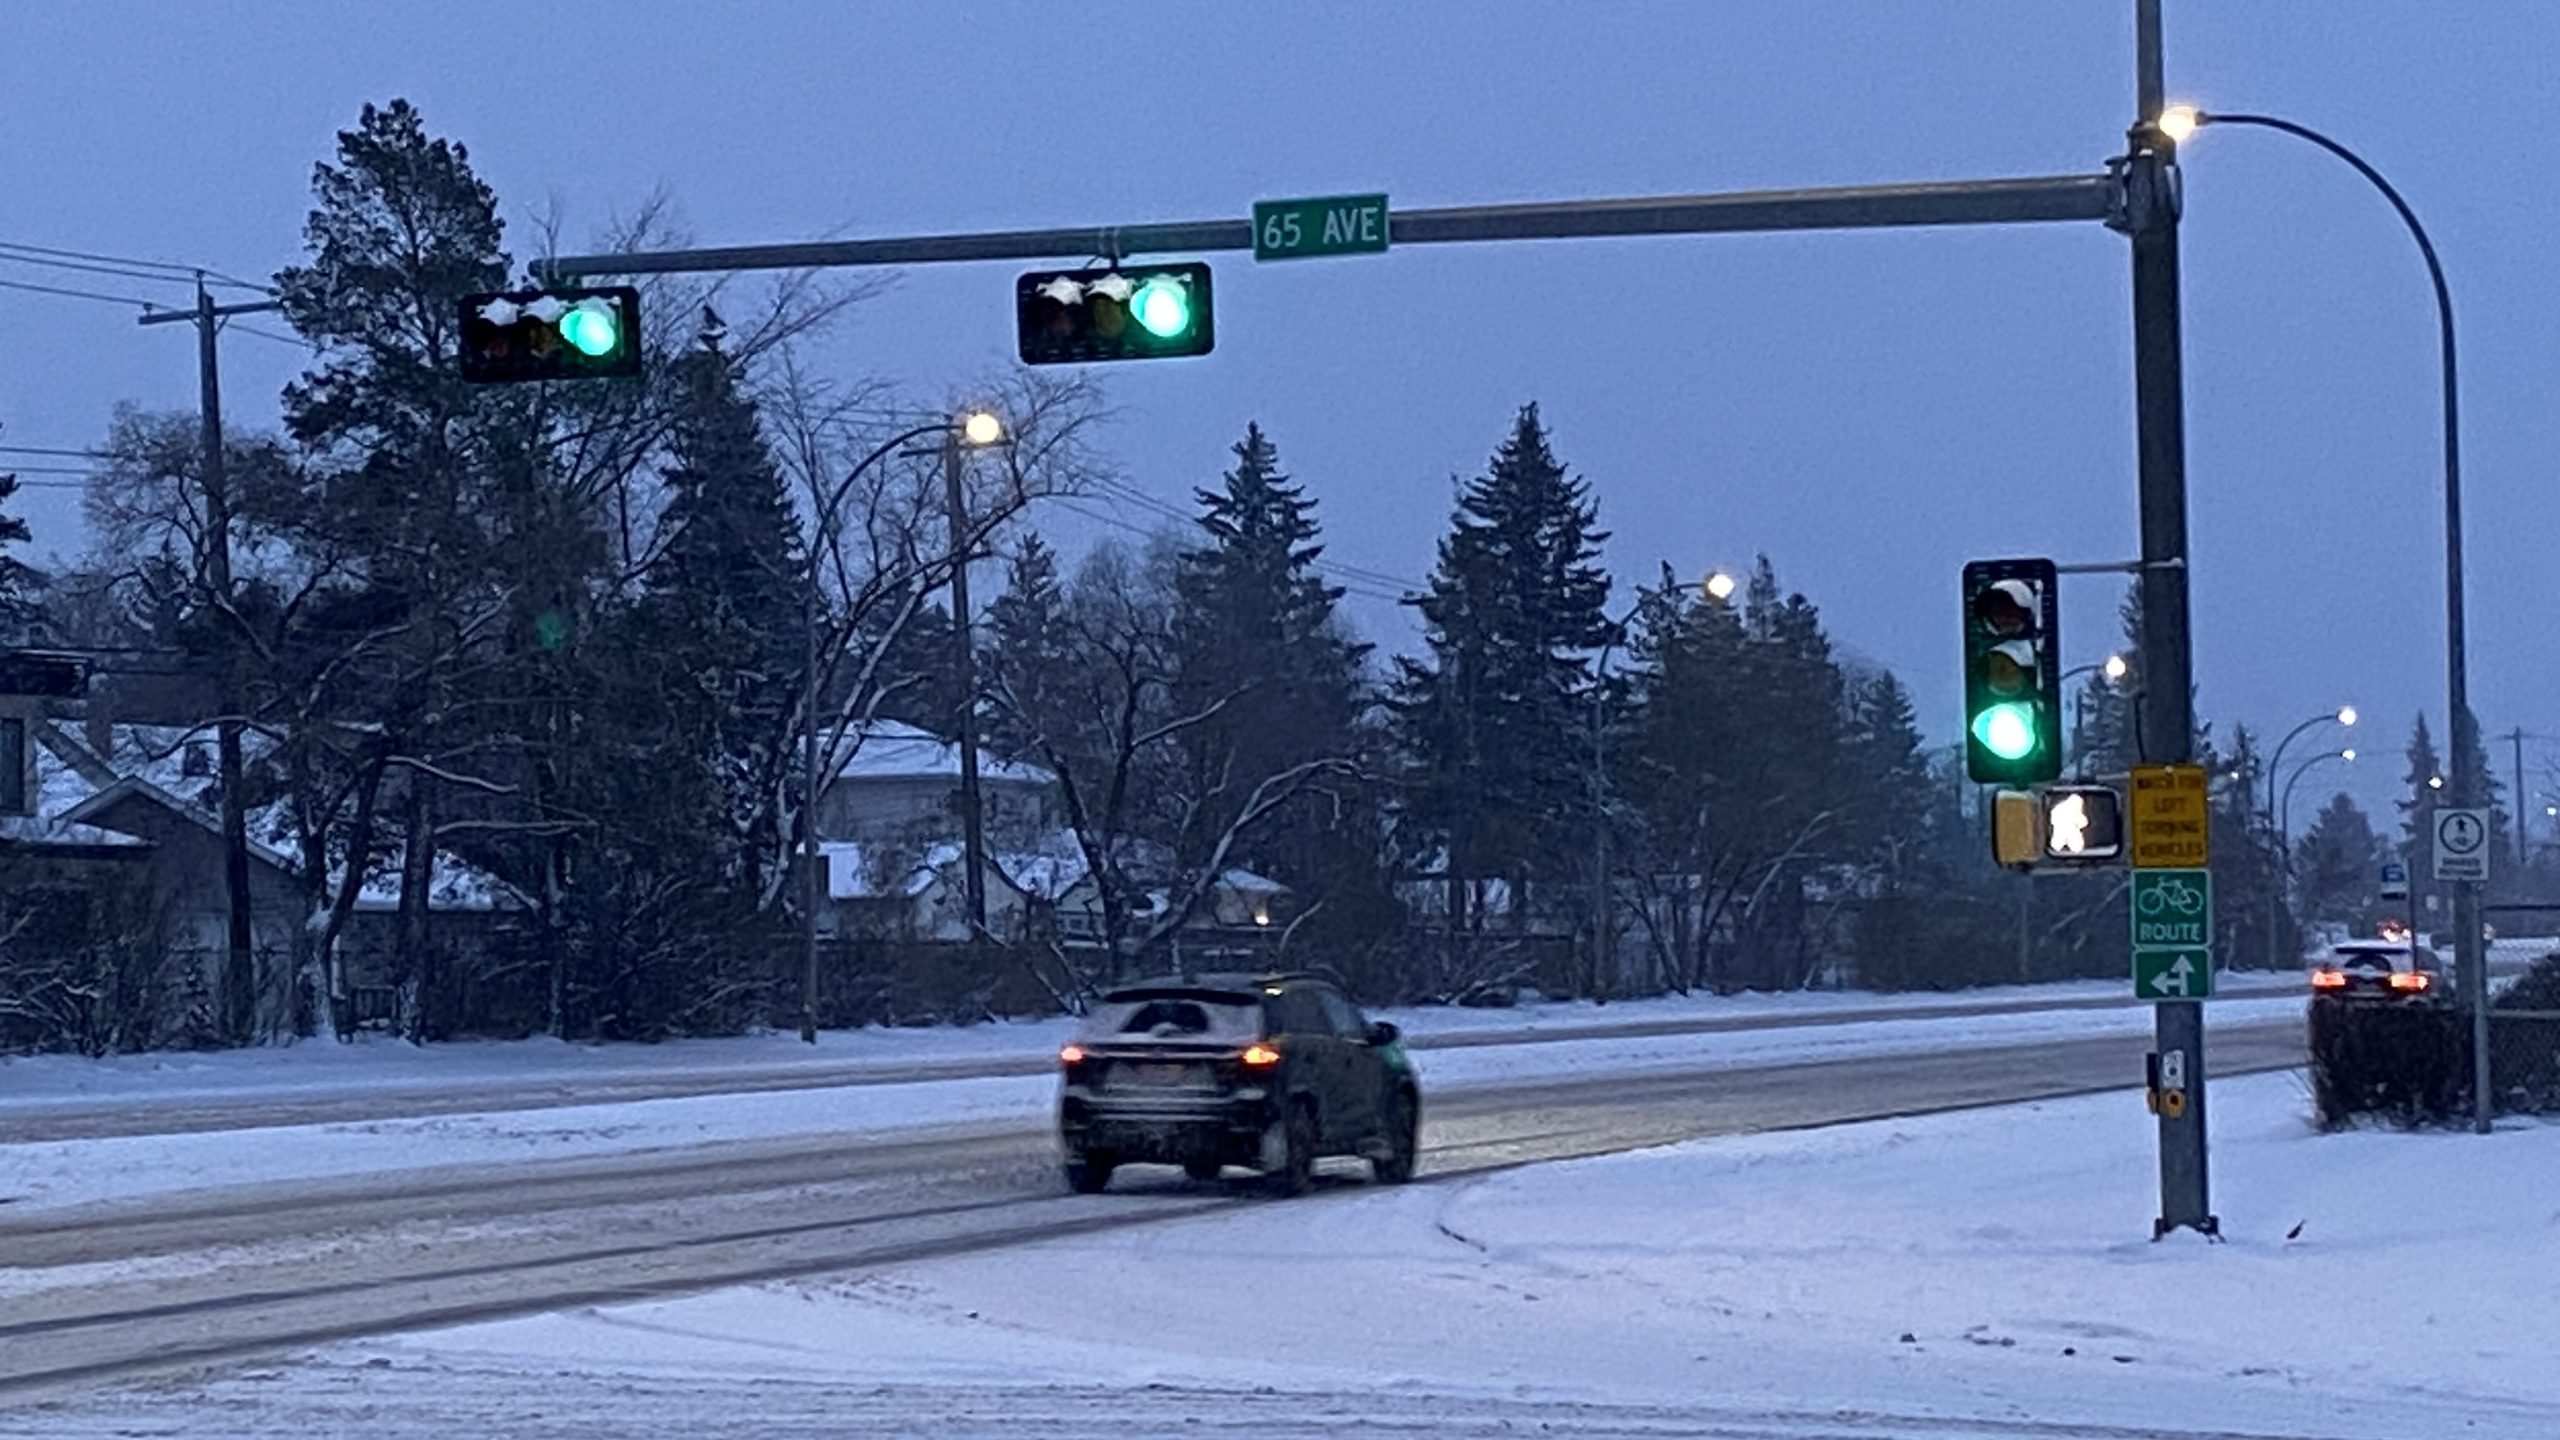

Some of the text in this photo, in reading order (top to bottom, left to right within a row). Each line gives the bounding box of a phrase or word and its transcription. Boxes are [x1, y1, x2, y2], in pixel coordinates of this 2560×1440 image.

[1263, 206, 1379, 249] 65 AVE
[2154, 797, 2188, 813] LEFT
[2140, 923, 2201, 941] ROUTE
